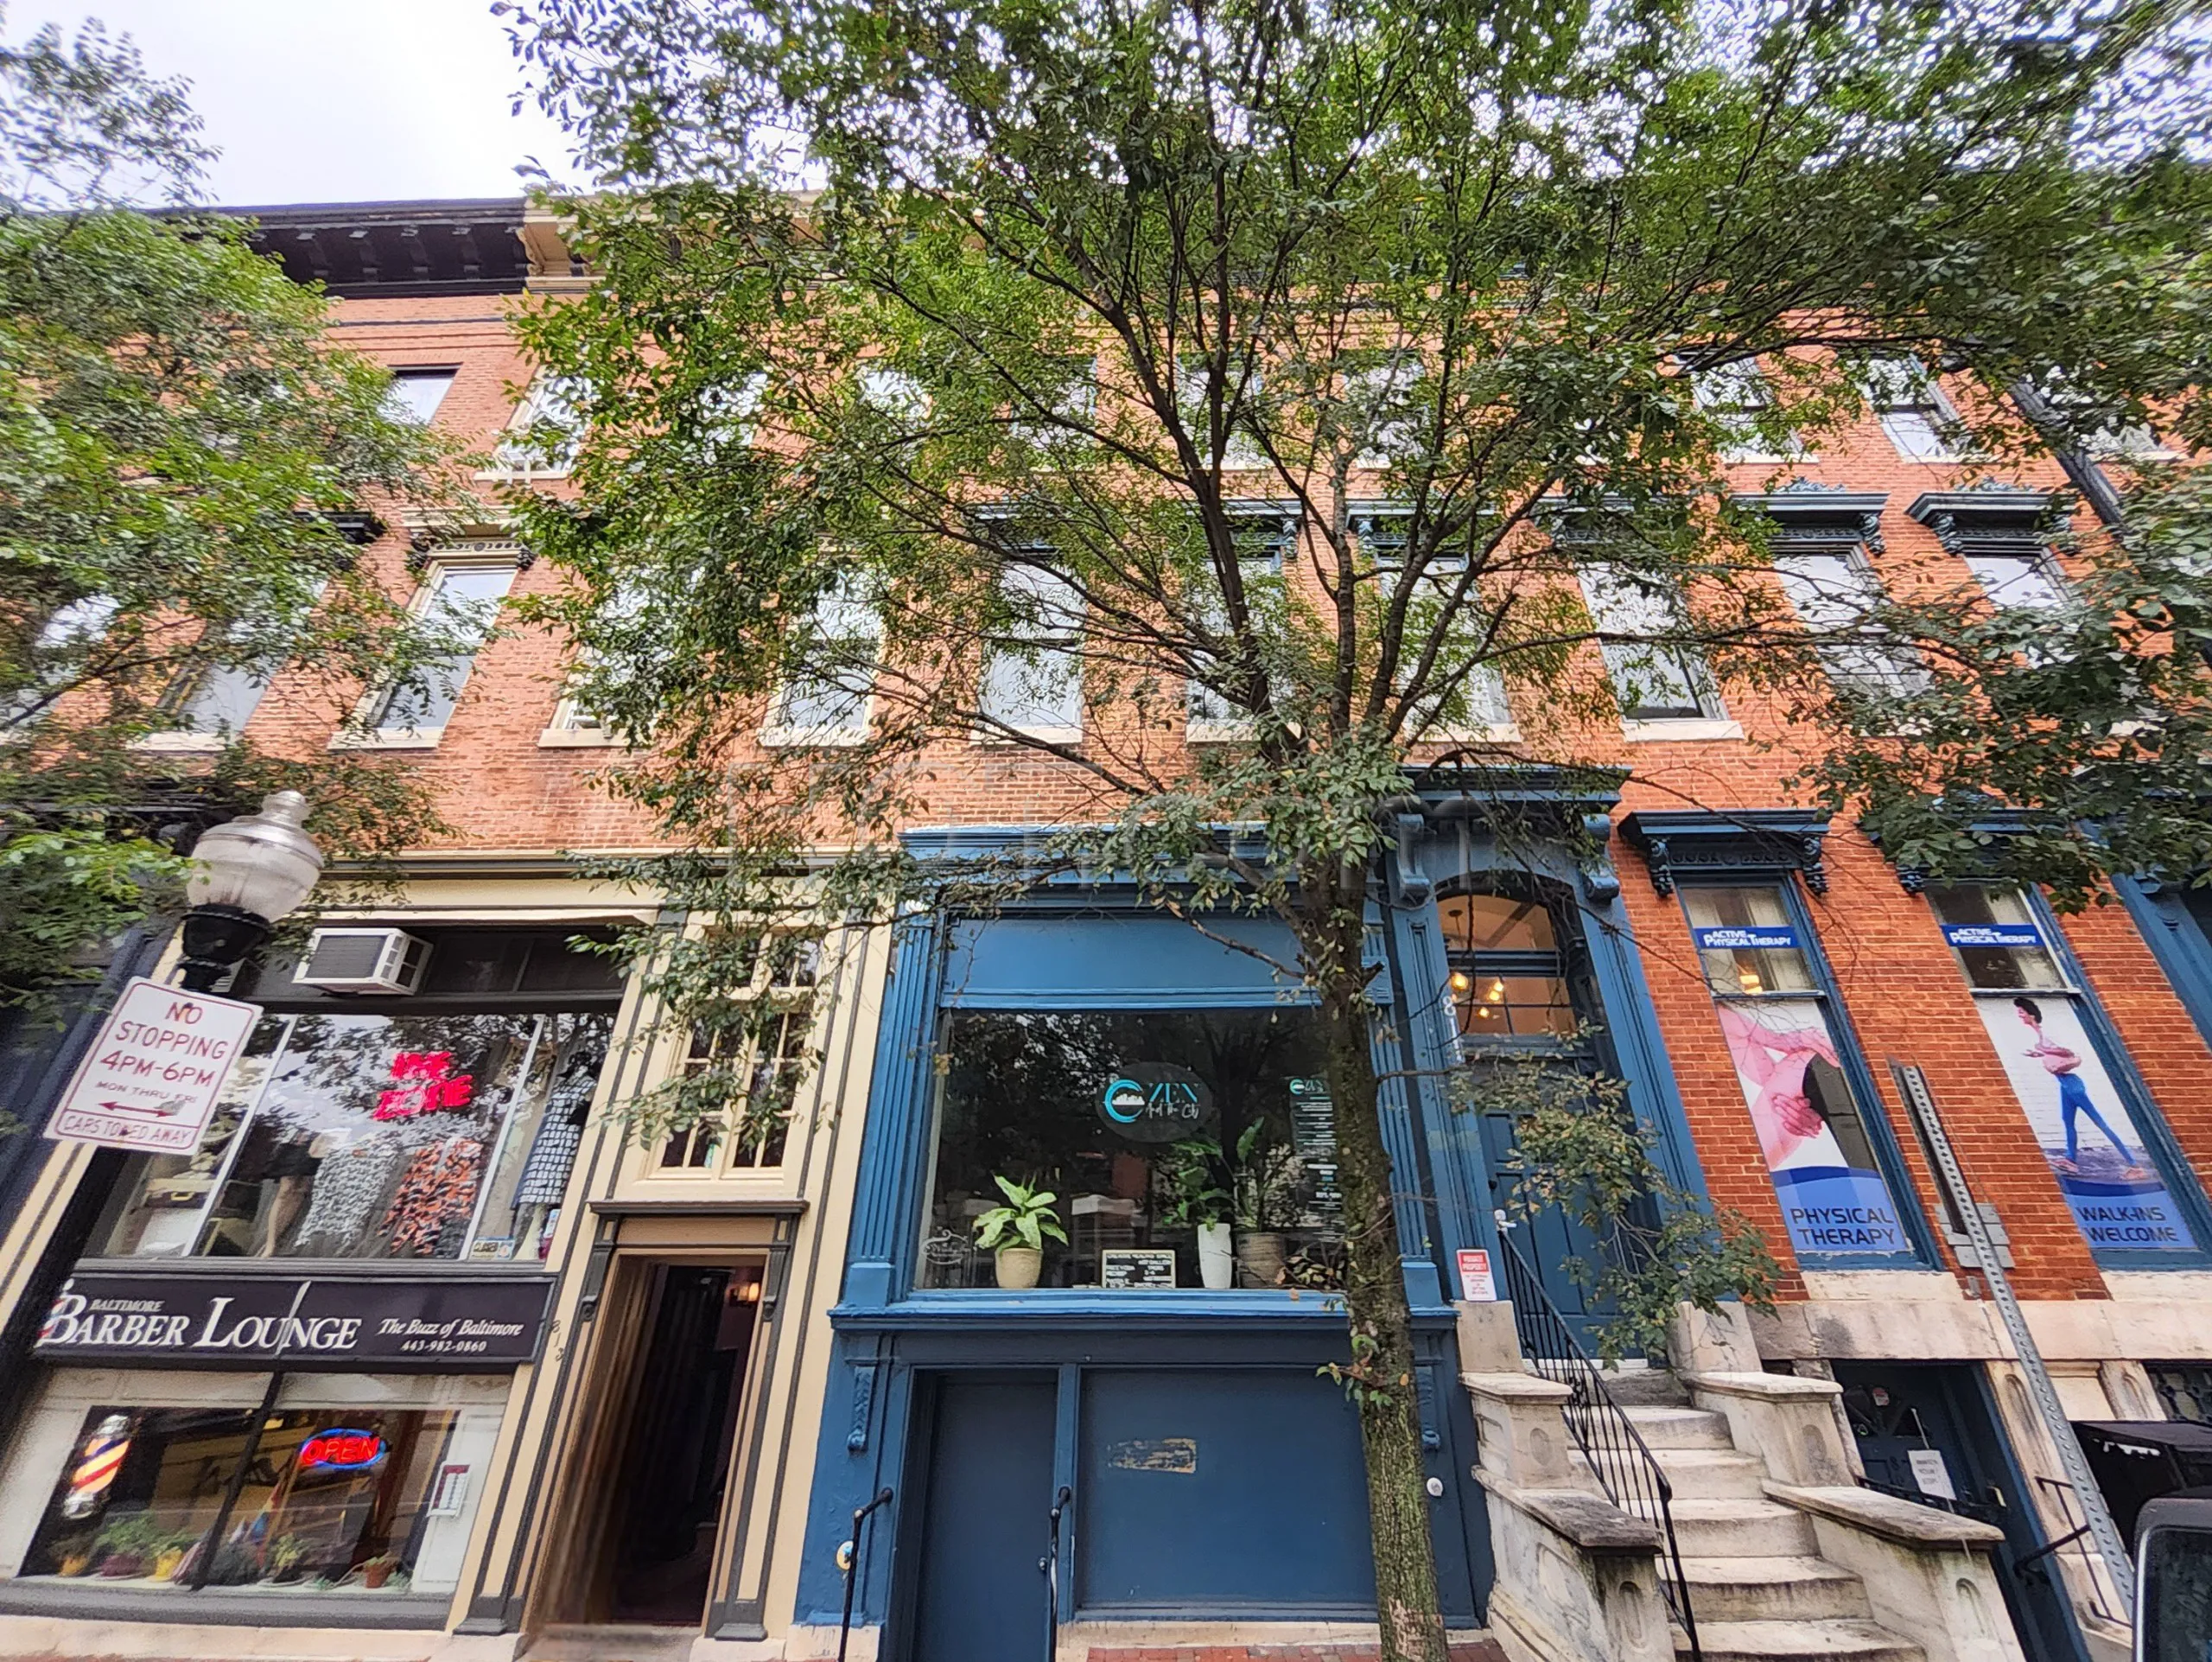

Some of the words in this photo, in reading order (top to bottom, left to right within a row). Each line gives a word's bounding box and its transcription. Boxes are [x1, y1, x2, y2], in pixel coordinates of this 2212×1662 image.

[1703, 934, 1751, 946] PHYSICAL
[1749, 934, 1791, 946] THERAPY
[165, 1002, 204, 1024] NO
[115, 1021, 229, 1060] STOPPING
[99, 1050, 216, 1087] 4PM-6PM
[96, 1081, 128, 1093] MON
[130, 1086, 168, 1102] THRU
[173, 1093, 198, 1105] FRI
[63, 1115, 99, 1133] CARS
[153, 1124, 191, 1144] AWAY
[1789, 1208, 1895, 1224] PHYSICAL
[2075, 1207, 2166, 1222] WALK-INS
[1797, 1228, 1895, 1245] THERAPY
[2083, 1227, 2180, 1242] WELCOME
[88, 1299, 166, 1312] BALTIMORE
[34, 1292, 191, 1348] BARBER
[191, 1296, 362, 1349] LOUNGE
[377, 1318, 404, 1335] The
[404, 1319, 440, 1336] Buzz
[439, 1318, 460, 1340] of
[456, 1318, 524, 1337] Baltimore
[400, 1340, 487, 1353] 443-982-0860
[302, 1436, 380, 1465] OPEN
